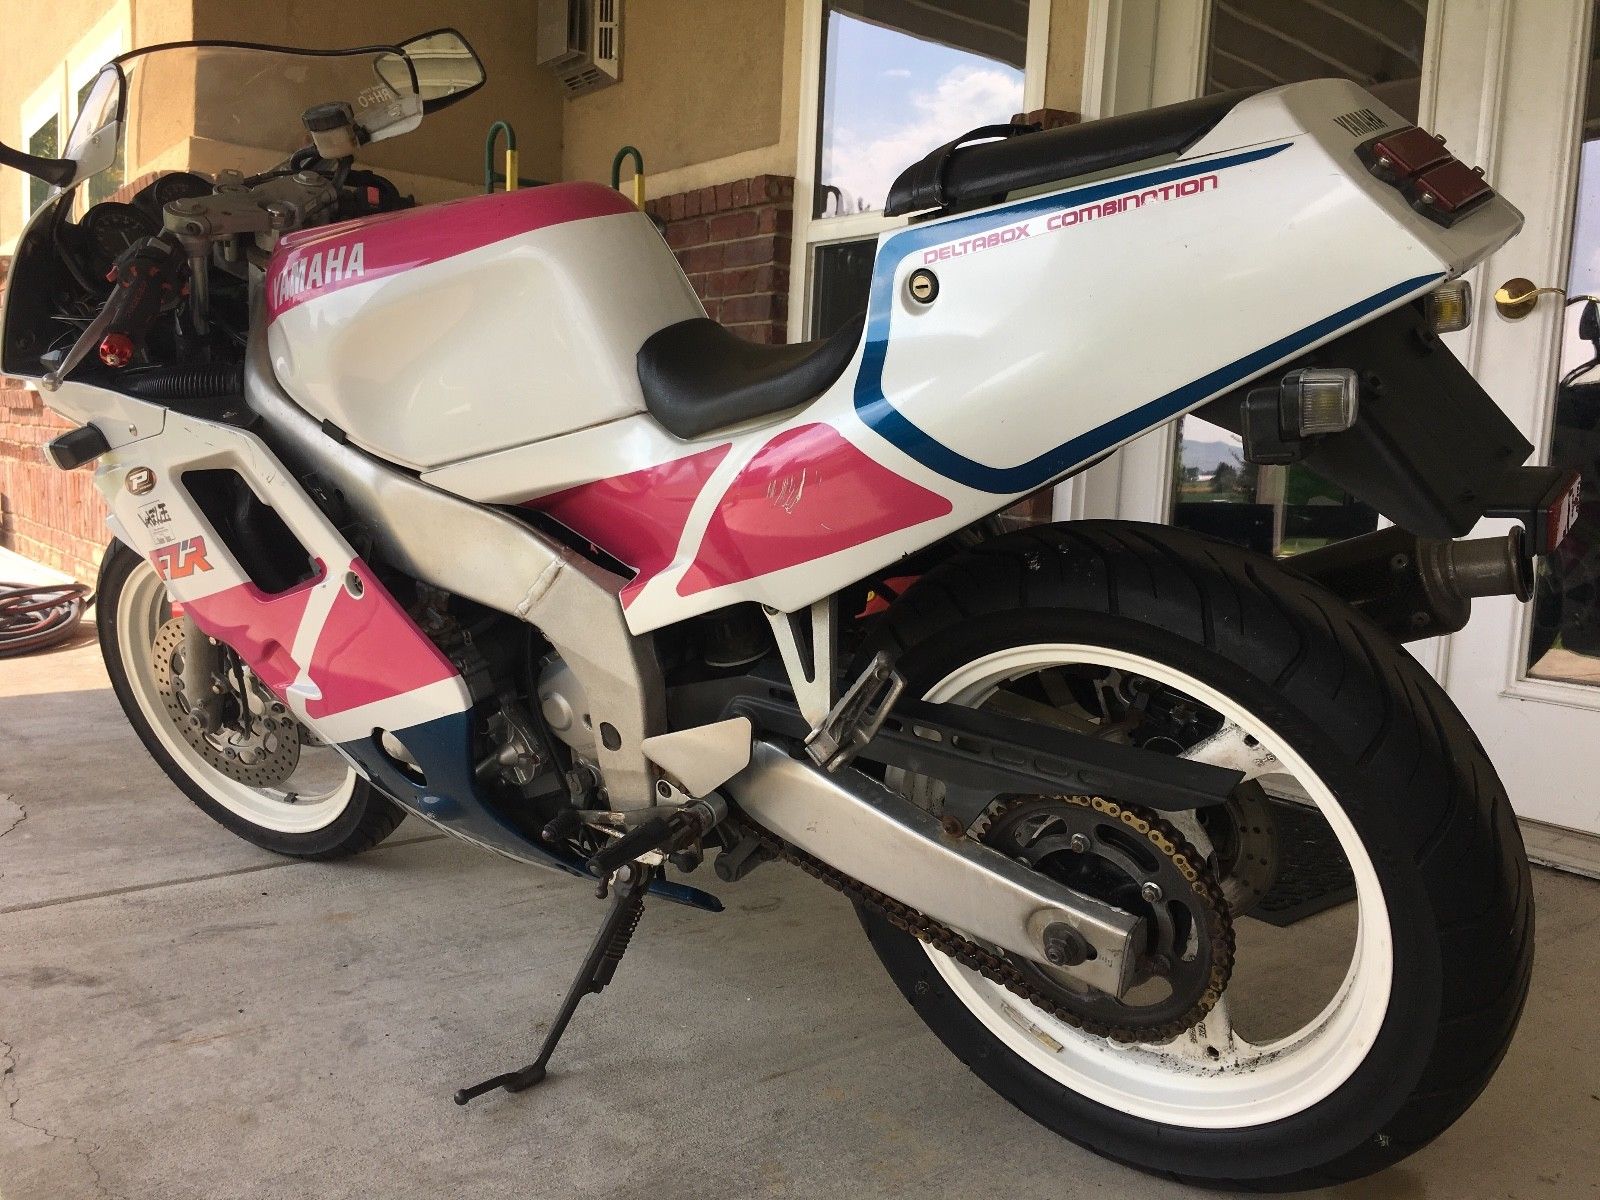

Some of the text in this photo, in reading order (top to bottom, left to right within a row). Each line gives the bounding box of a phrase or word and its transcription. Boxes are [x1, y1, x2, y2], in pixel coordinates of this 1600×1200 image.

[1333, 108, 1388, 137] YAMAHA
[923, 174, 1218, 265] DELTABOX COMBINATION
[273, 242, 364, 310] YAMAHA
